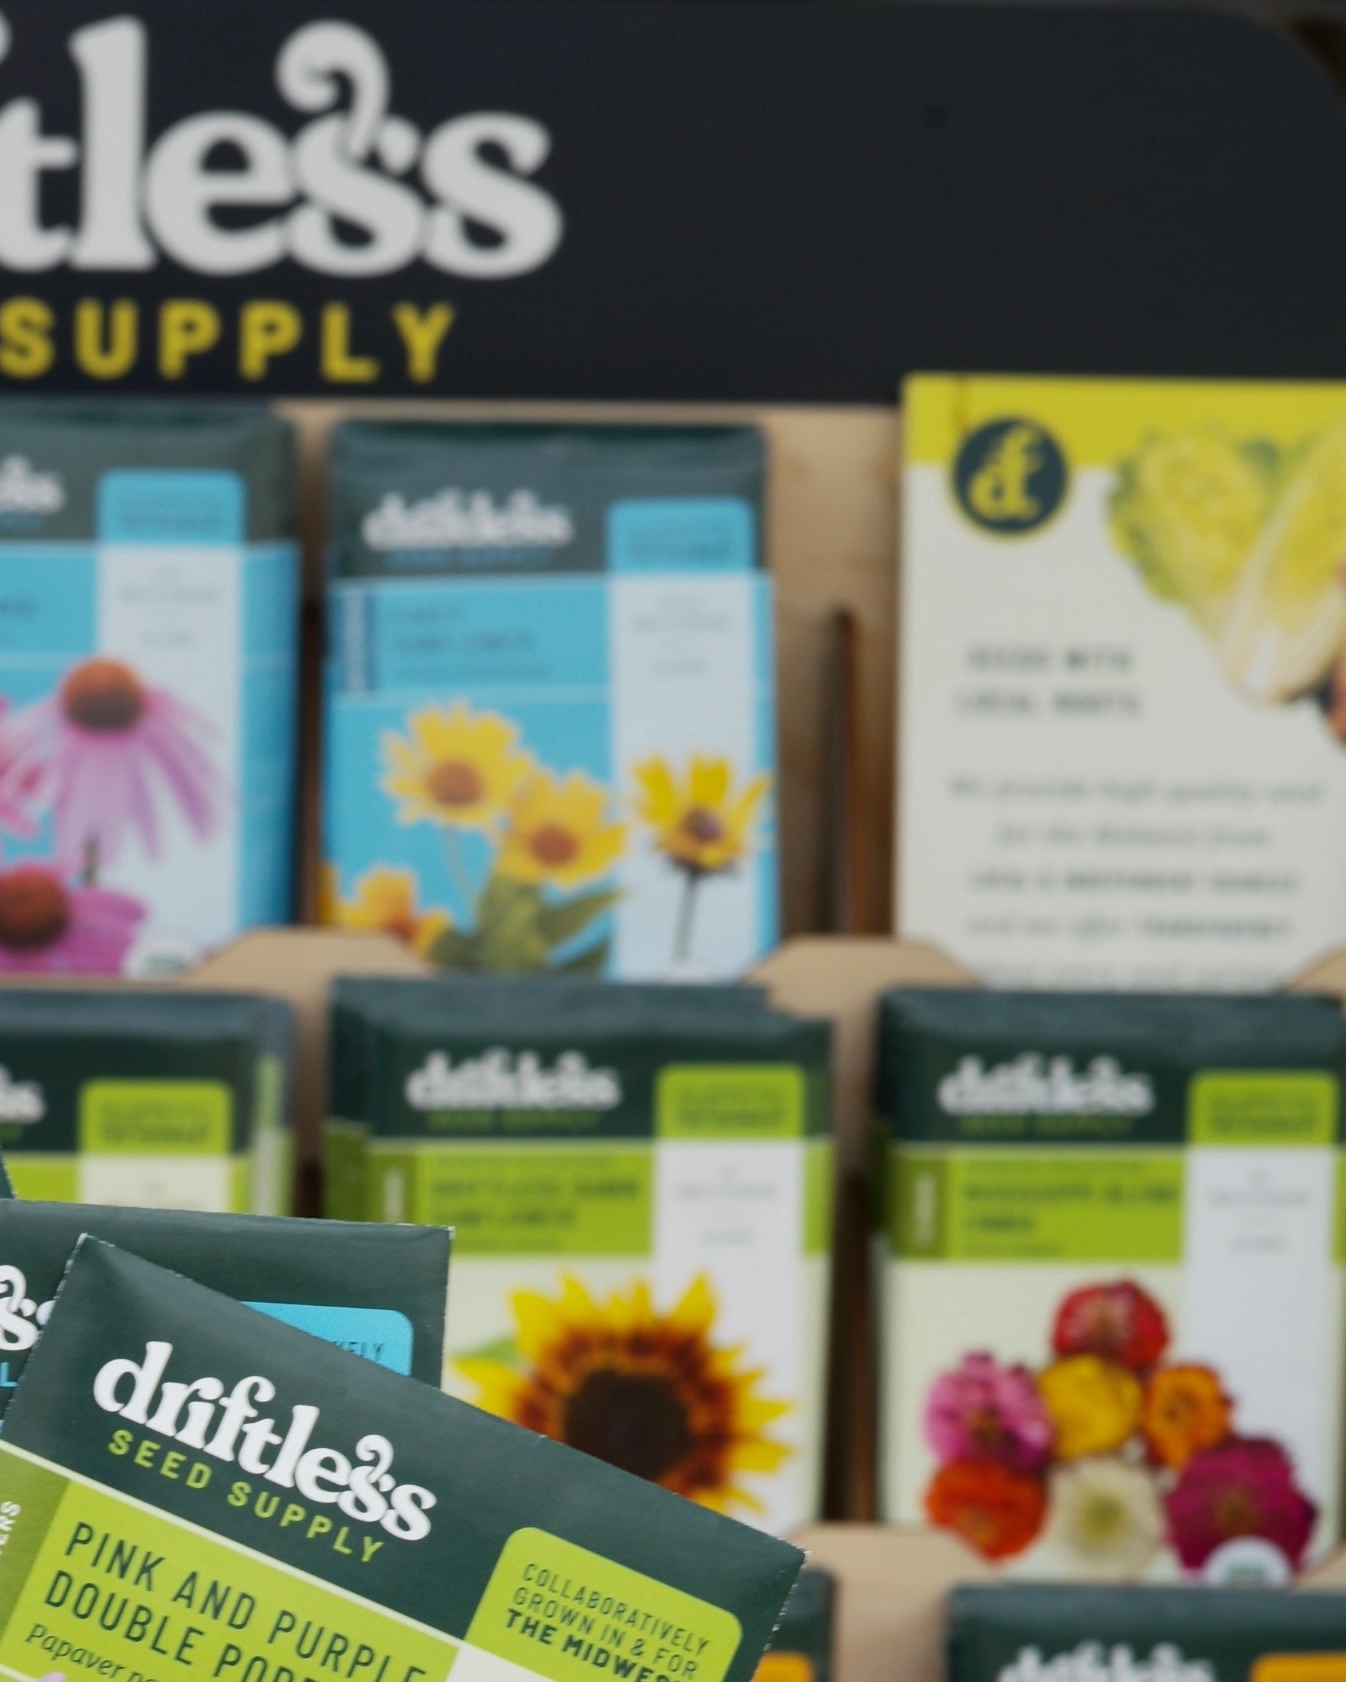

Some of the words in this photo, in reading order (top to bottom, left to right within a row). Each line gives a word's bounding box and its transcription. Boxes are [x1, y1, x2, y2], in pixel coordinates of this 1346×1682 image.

[93, 1340, 438, 1541] driftless
[107, 1429, 213, 1490] SEED
[226, 1481, 386, 1564] SUPPLY
[43, 1569, 206, 1666] DOUBLE
[63, 1521, 167, 1593] PINK
[171, 1569, 257, 1632] AND
[521, 1562, 712, 1657] COLLABORATIVELY
[24, 1622, 125, 1681] Papaver
[504, 1608, 559, 1646] THE
[512, 1586, 597, 1634] GROWN
[602, 1624, 625, 1649] IN
[629, 1638, 646, 1658] &
[653, 1652, 699, 1681] FOR
